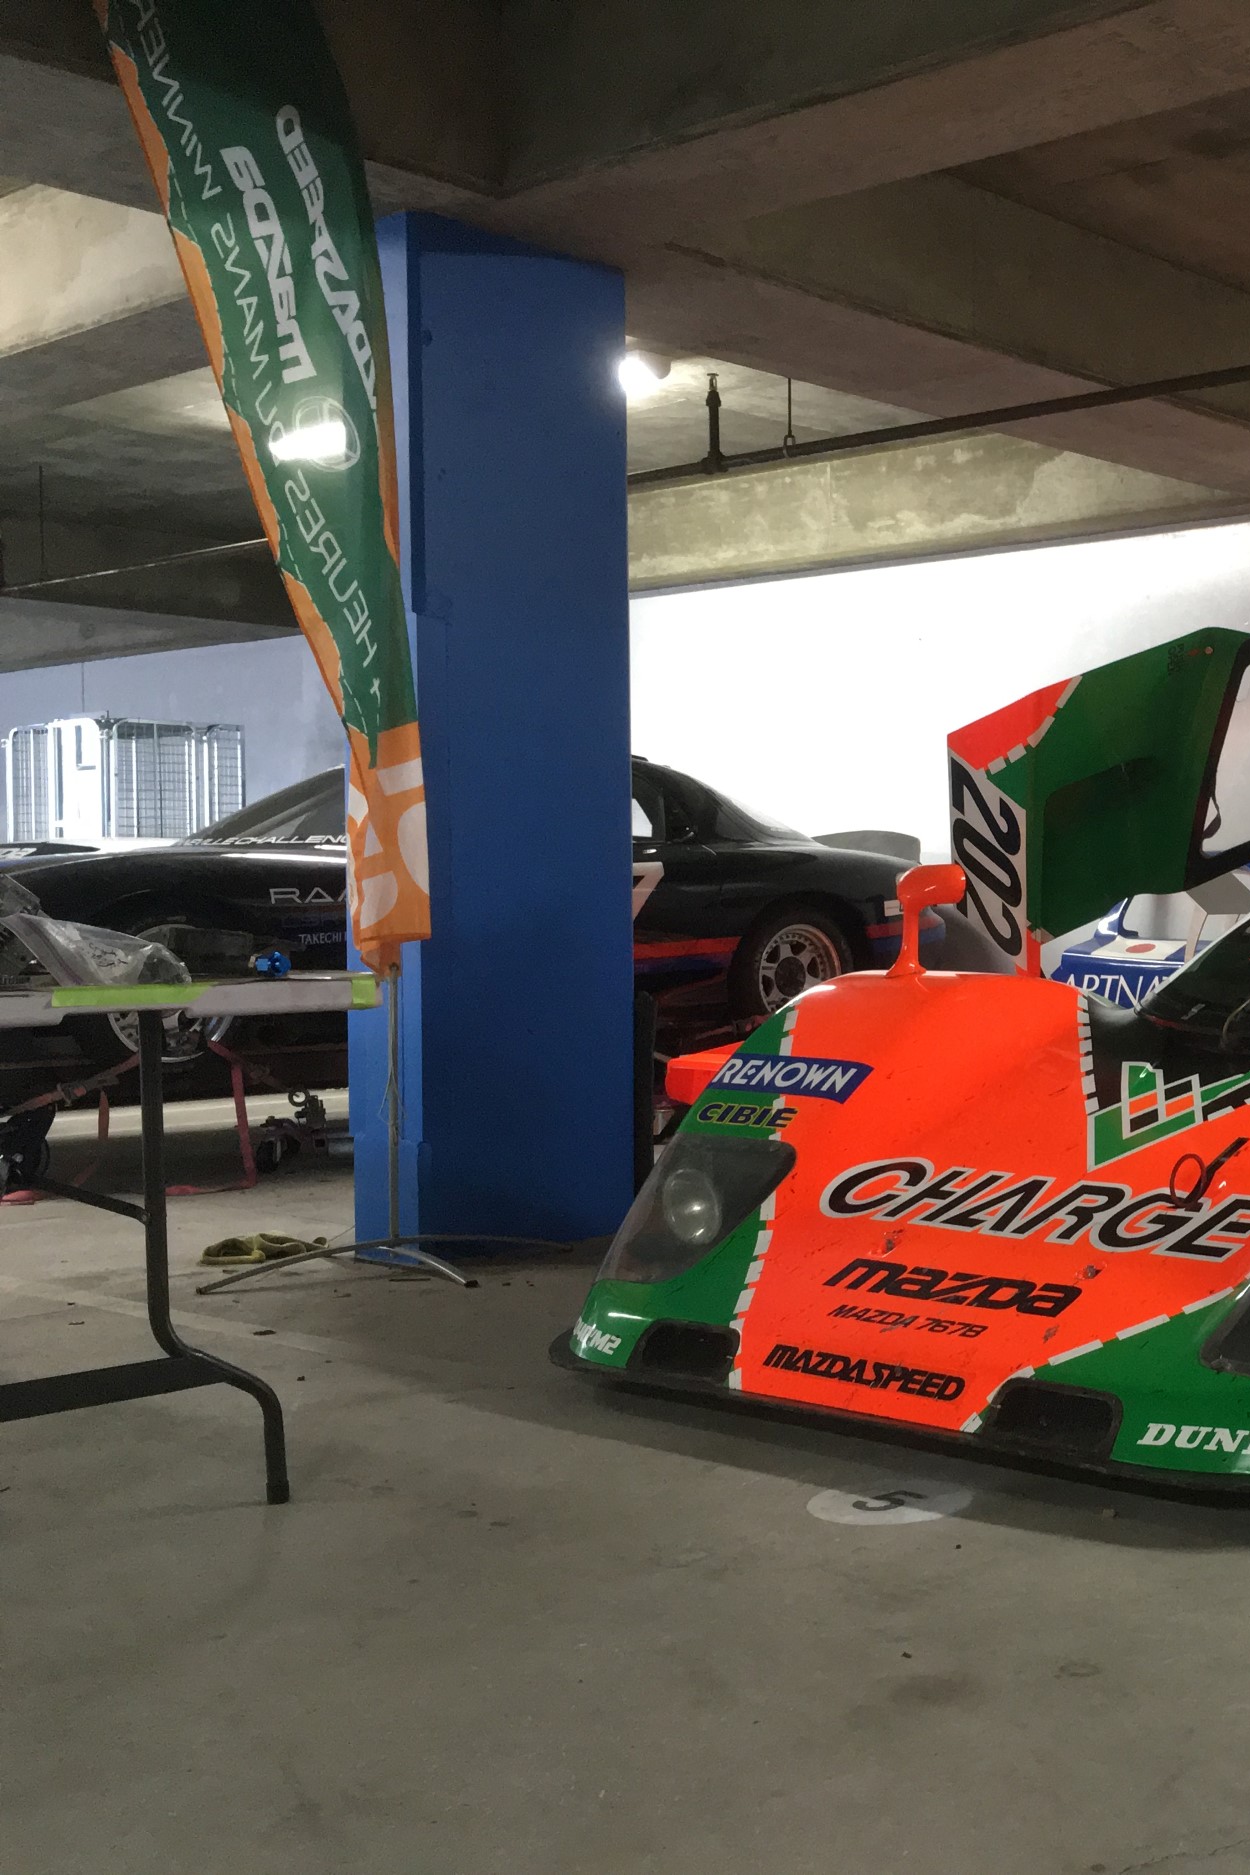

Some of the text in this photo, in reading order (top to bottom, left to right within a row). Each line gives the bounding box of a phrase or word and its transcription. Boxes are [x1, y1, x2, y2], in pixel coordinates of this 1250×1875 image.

[298, 932, 343, 945] TAKECHI
[711, 1058, 858, 1094] RENOWN
[827, 1304, 989, 1340] MAZDA 767B
[762, 1343, 966, 1402] MAZDASPEED
